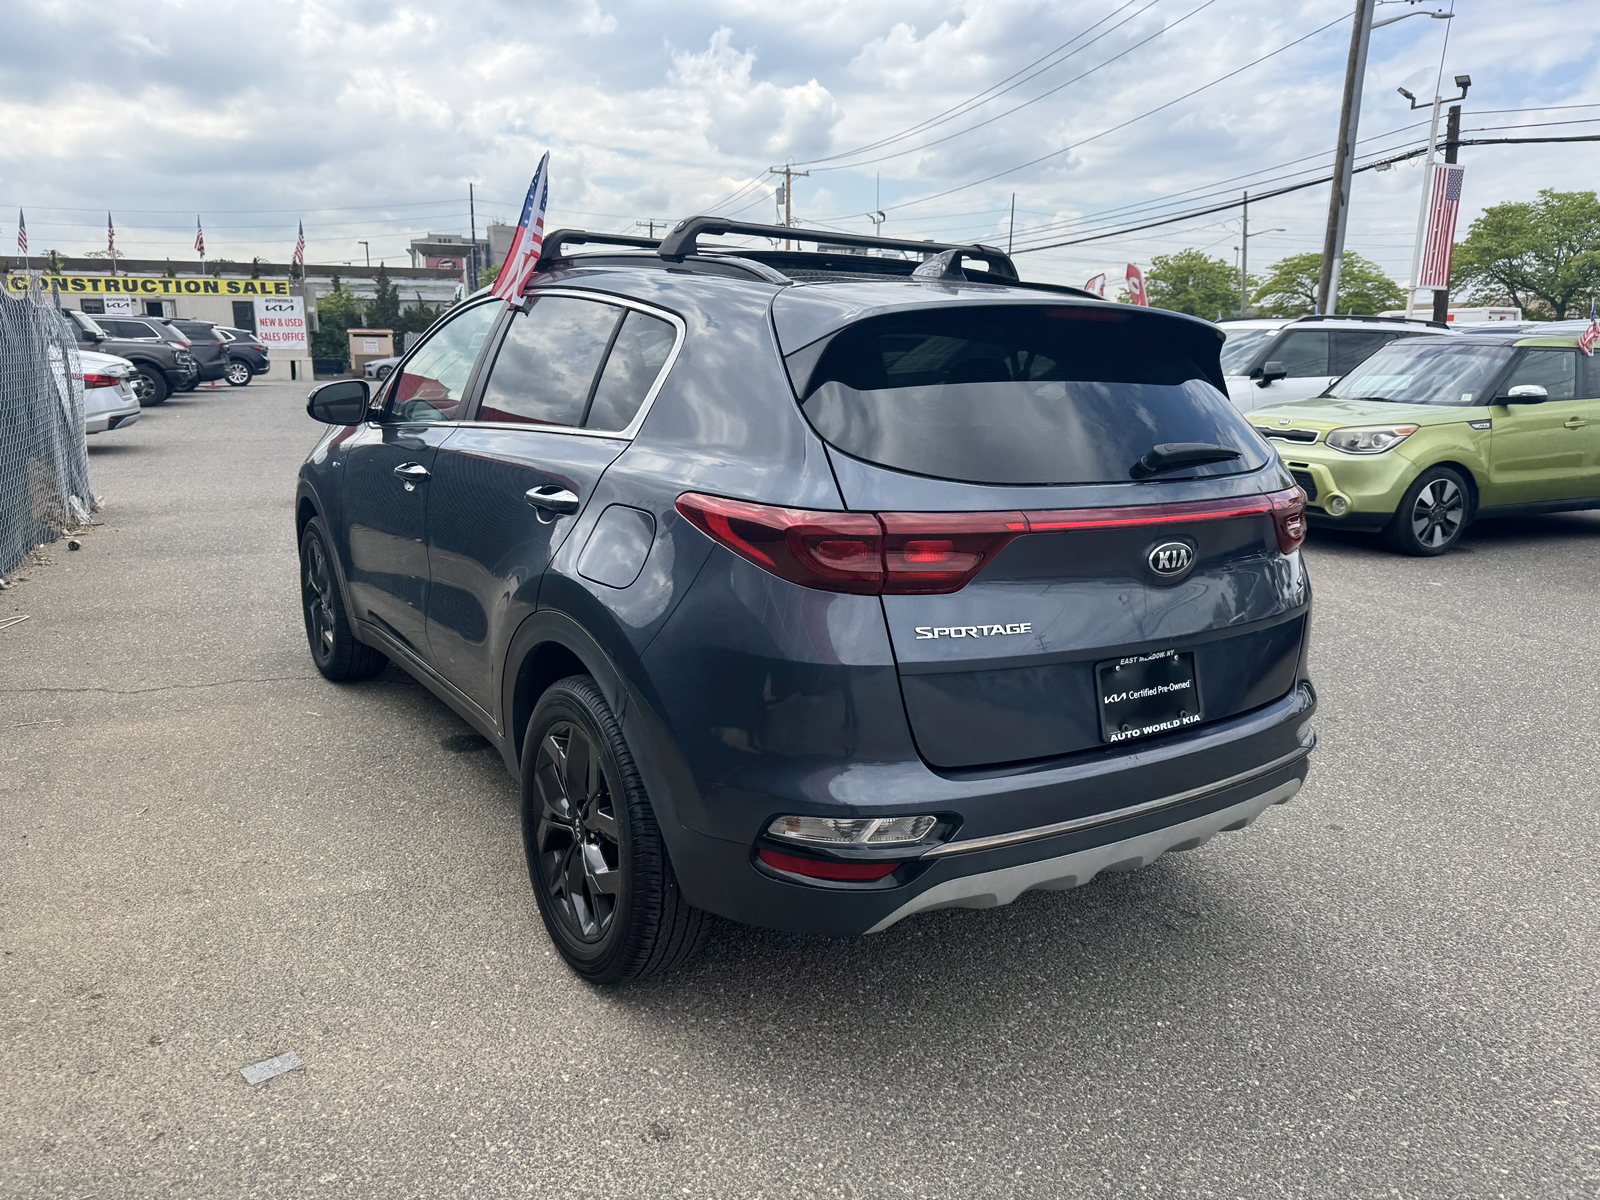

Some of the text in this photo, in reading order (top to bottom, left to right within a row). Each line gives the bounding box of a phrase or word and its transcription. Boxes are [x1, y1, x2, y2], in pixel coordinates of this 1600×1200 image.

[227, 281, 287, 295] SALE
[265, 304, 295, 312] KIA
[259, 317, 303, 328] NEW & USED
[259, 331, 305, 342] SALES OFFICE
[1158, 549, 1188, 569] KIA
[914, 622, 1033, 640] SPORTAGE
[1120, 656, 1138, 665] EAST
[1104, 693, 1126, 703] KIA
[1129, 687, 1157, 699] Certified
[1110, 715, 1200, 742] AUTO WORLD KIA
